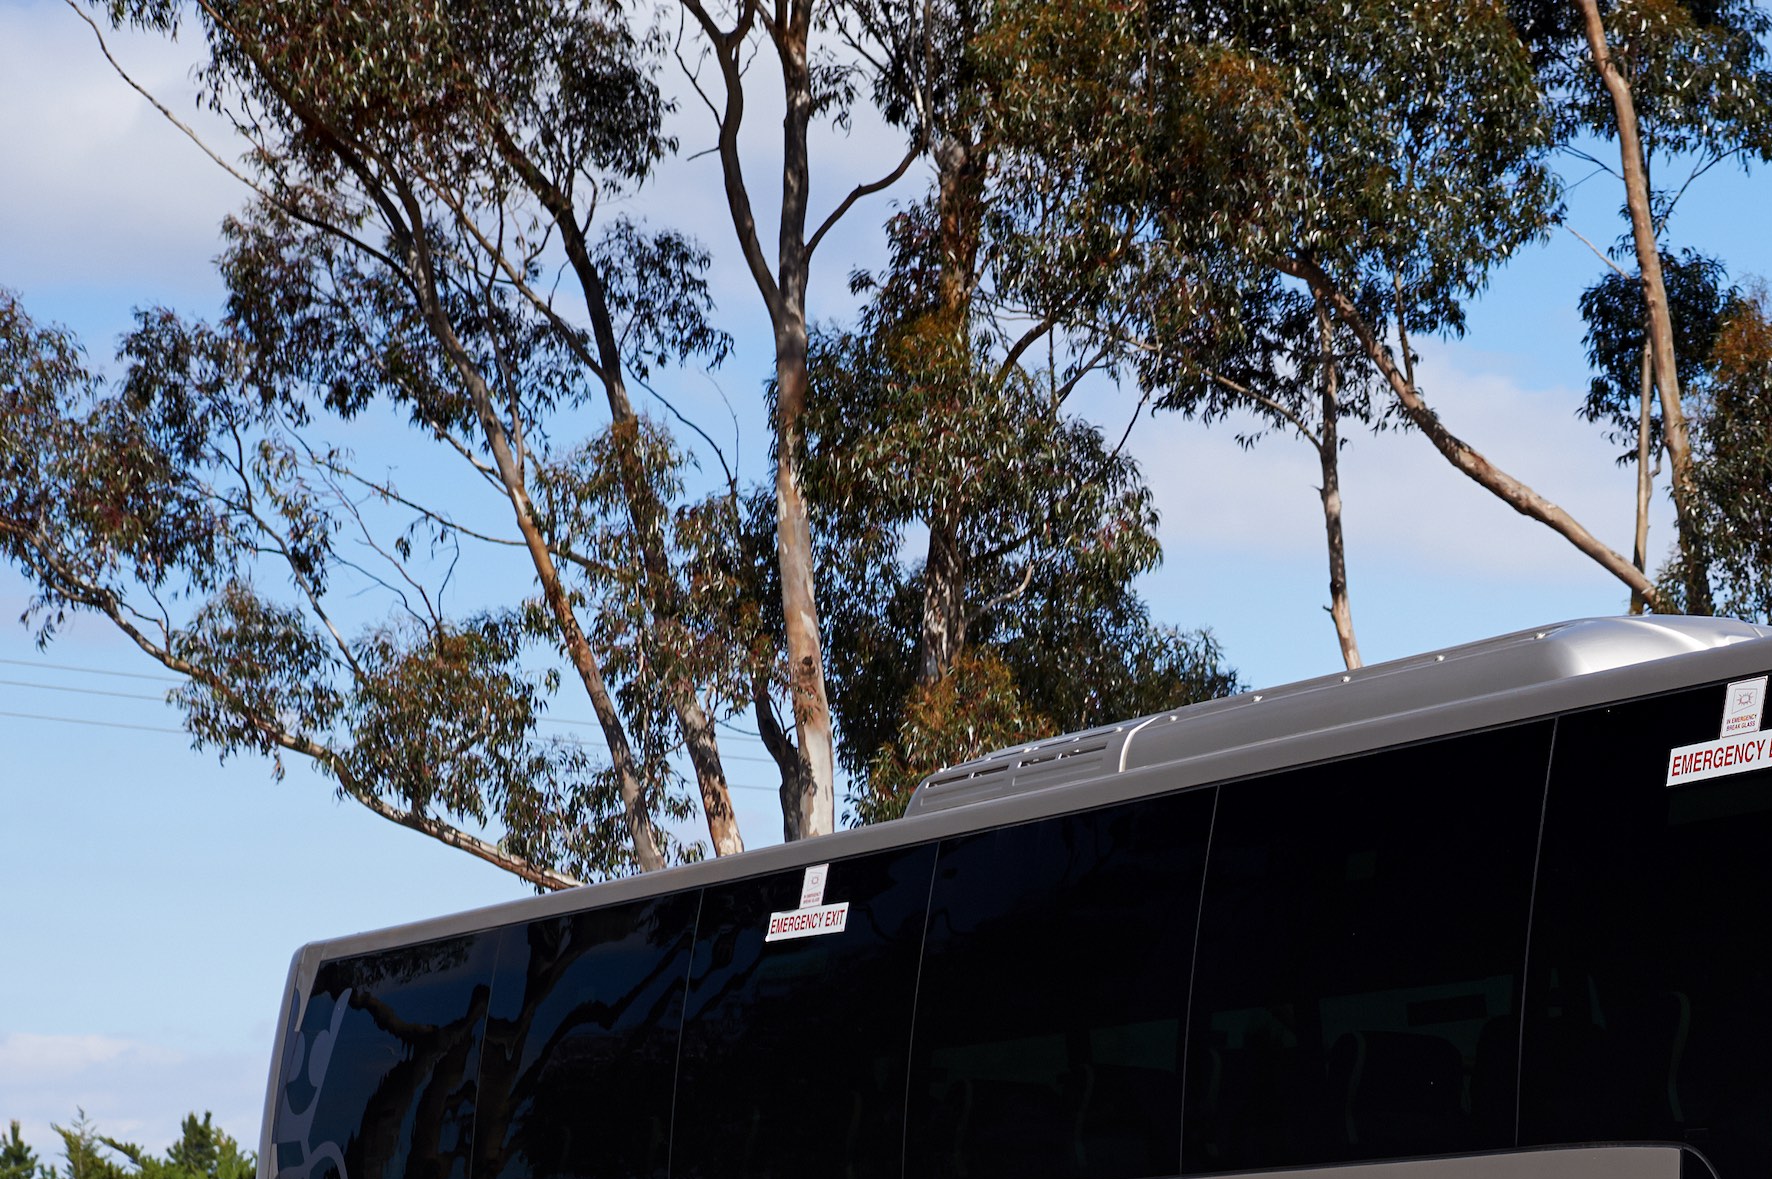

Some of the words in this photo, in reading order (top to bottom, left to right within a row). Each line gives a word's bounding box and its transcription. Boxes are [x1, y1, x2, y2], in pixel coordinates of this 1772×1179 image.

[1731, 714, 1757, 723] EMERGENCY
[1671, 739, 1766, 777] EMERGENCY
[770, 912, 824, 934] EMERGENCY
[825, 909, 845, 927] EXIT
